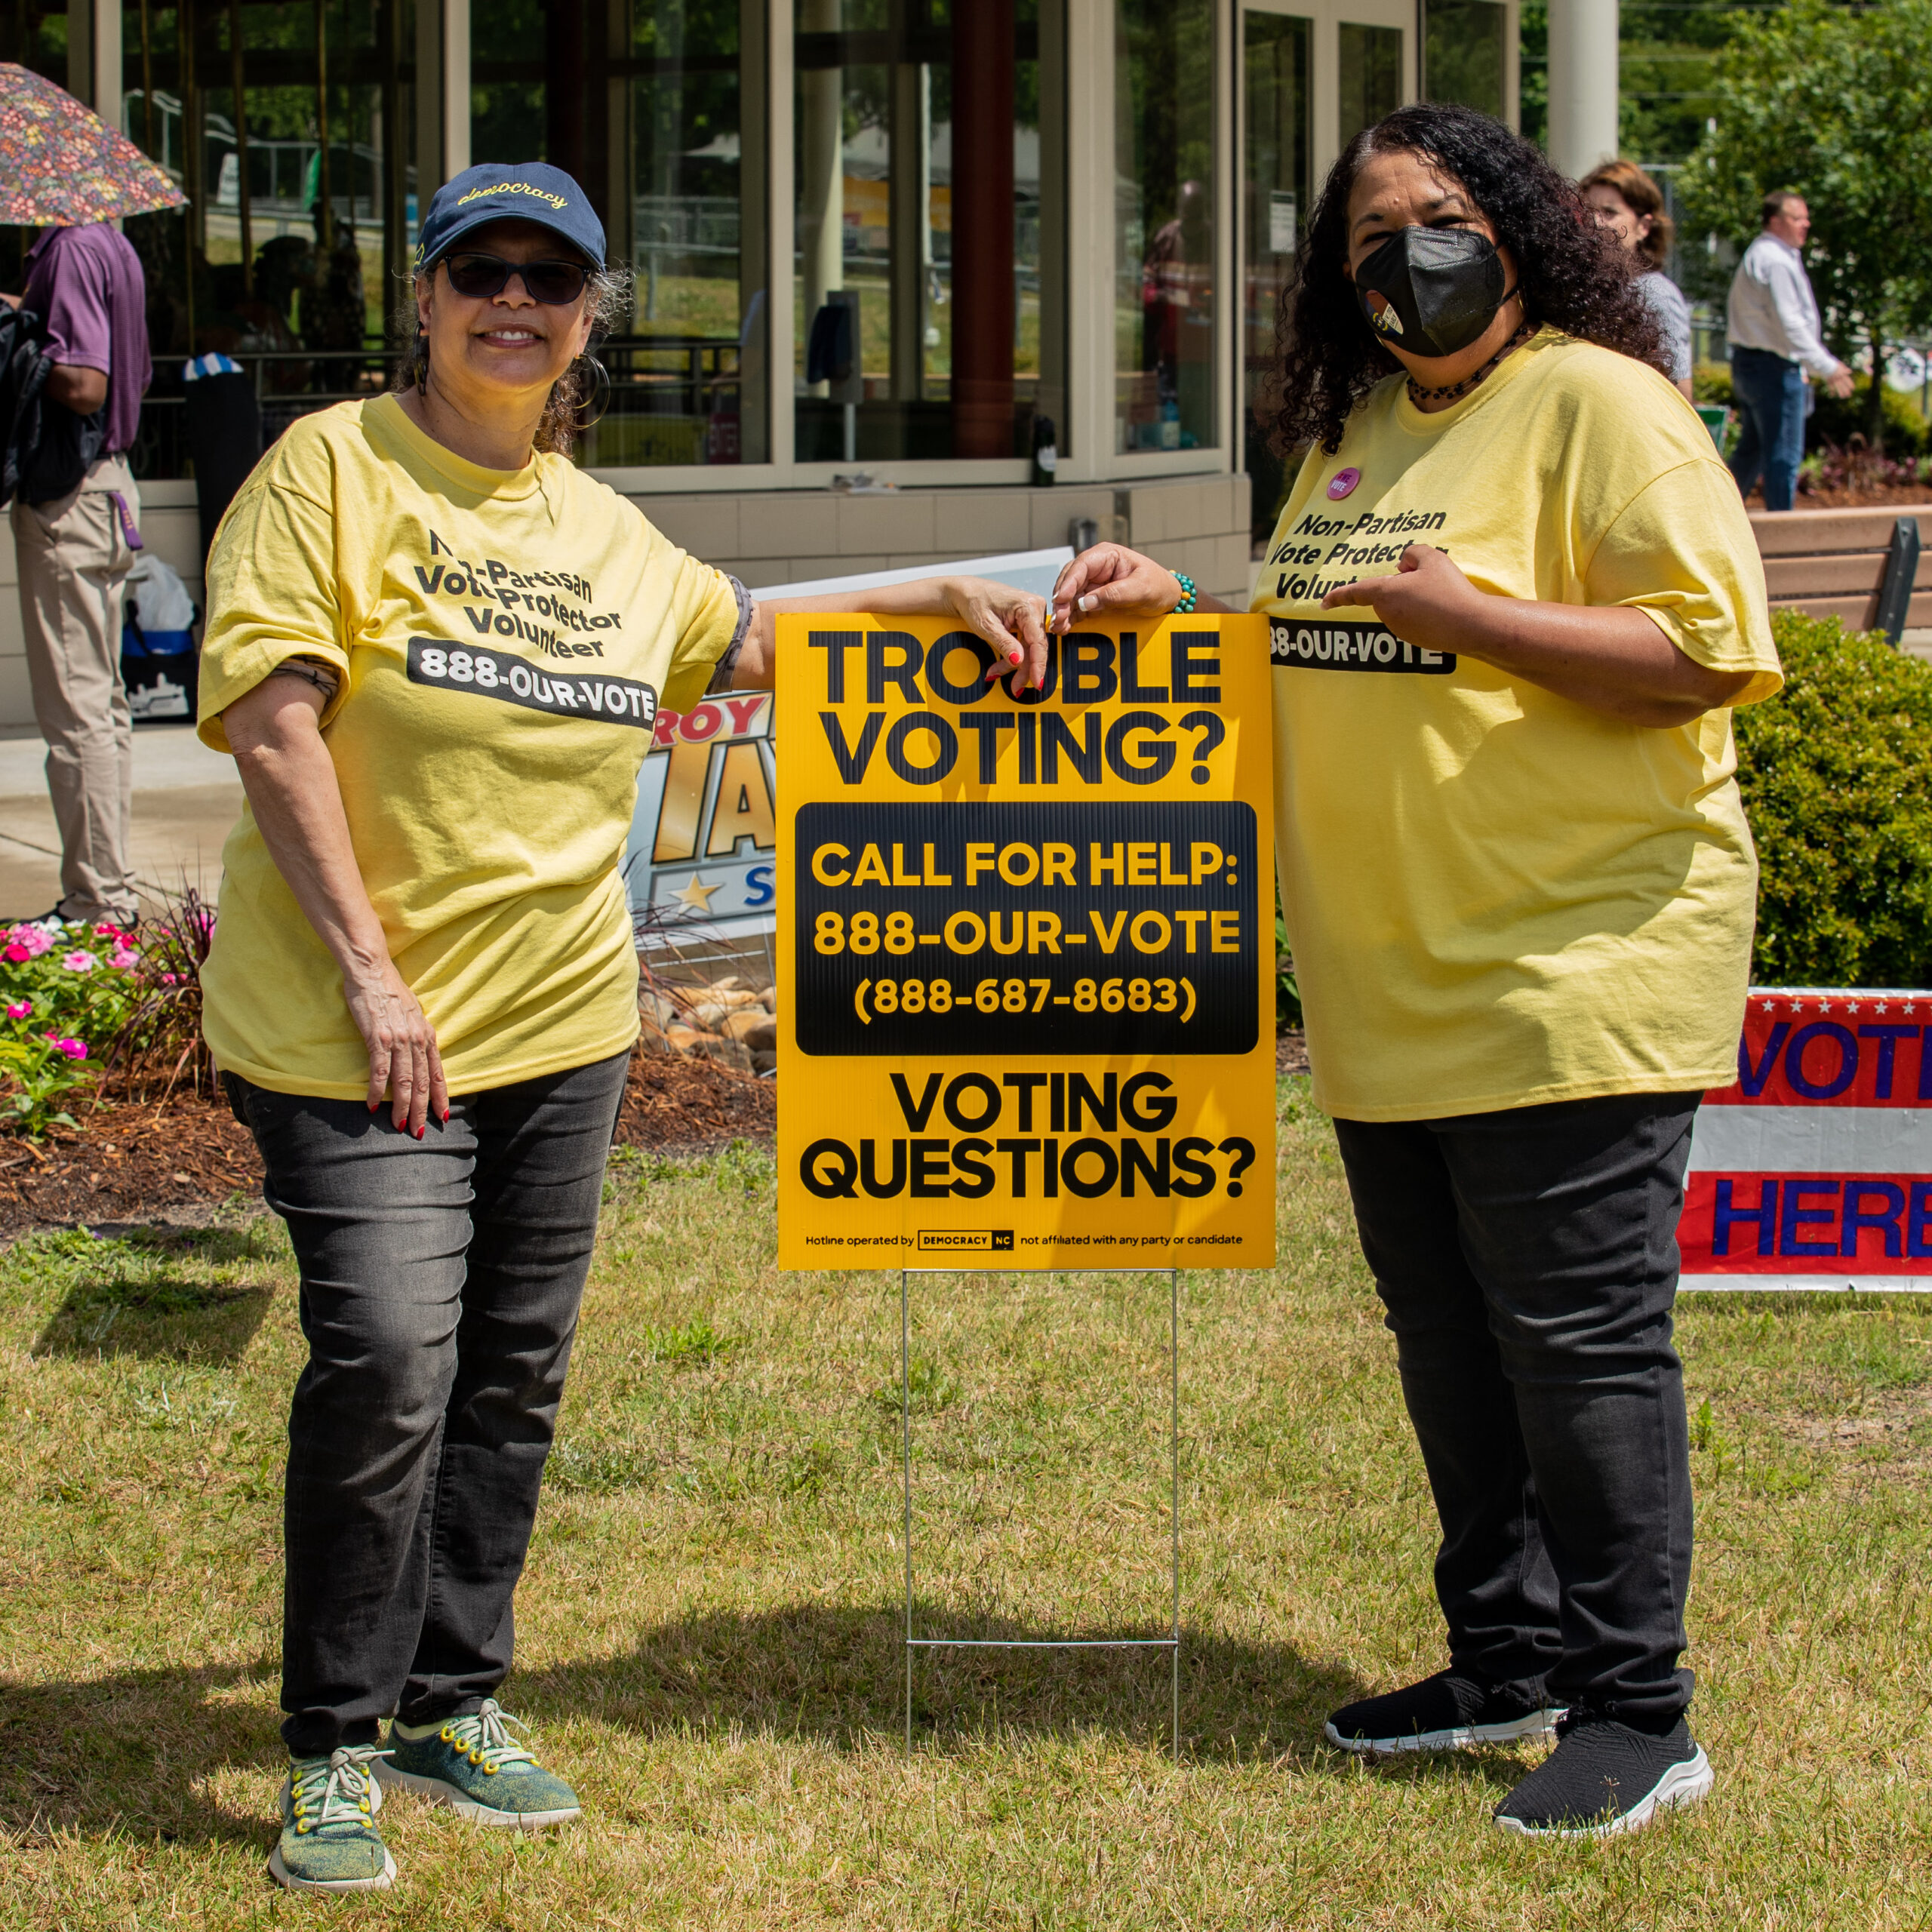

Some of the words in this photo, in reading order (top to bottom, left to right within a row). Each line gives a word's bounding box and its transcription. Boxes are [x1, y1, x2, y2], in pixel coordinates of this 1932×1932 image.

[457, 183, 568, 210] democracy
[1331, 479, 1347, 492] VOTE
[1293, 509, 1447, 537] Non-Partisan
[429, 528, 592, 604] Nn-Partisan
[463, 606, 605, 659] Volunteer
[494, 588, 623, 632] Protector
[420, 648, 655, 722] 888-OUR-VOTE
[808, 631, 1221, 705] TROUBLE
[819, 710, 1226, 786] VOTING?
[811, 842, 952, 886] CALL
[966, 842, 1077, 886] FOR
[1091, 842, 1237, 886] HELP:
[814, 910, 1240, 955] 888-OUR-VOTE
[854, 977, 1196, 1025] (888-687-8683)
[1737, 1021, 1932, 1100] VOT
[890, 1072, 1177, 1133] VOTING
[799, 1137, 1256, 1199] QUESTIONS?
[806, 1235, 844, 1245] Hotline
[847, 1235, 898, 1247] operated
[900, 1235, 915, 1247] by
[924, 1236, 987, 1244] DEMOCRACY
[995, 1236, 1011, 1244] NC
[1020, 1235, 1039, 1244] not
[1041, 1235, 1091, 1244] affiliated
[1093, 1235, 1116, 1244] with
[1118, 1236, 1139, 1246] any
[1141, 1235, 1171, 1246] party
[1173, 1236, 1184, 1244] or
[1187, 1234, 1243, 1244] candidate
